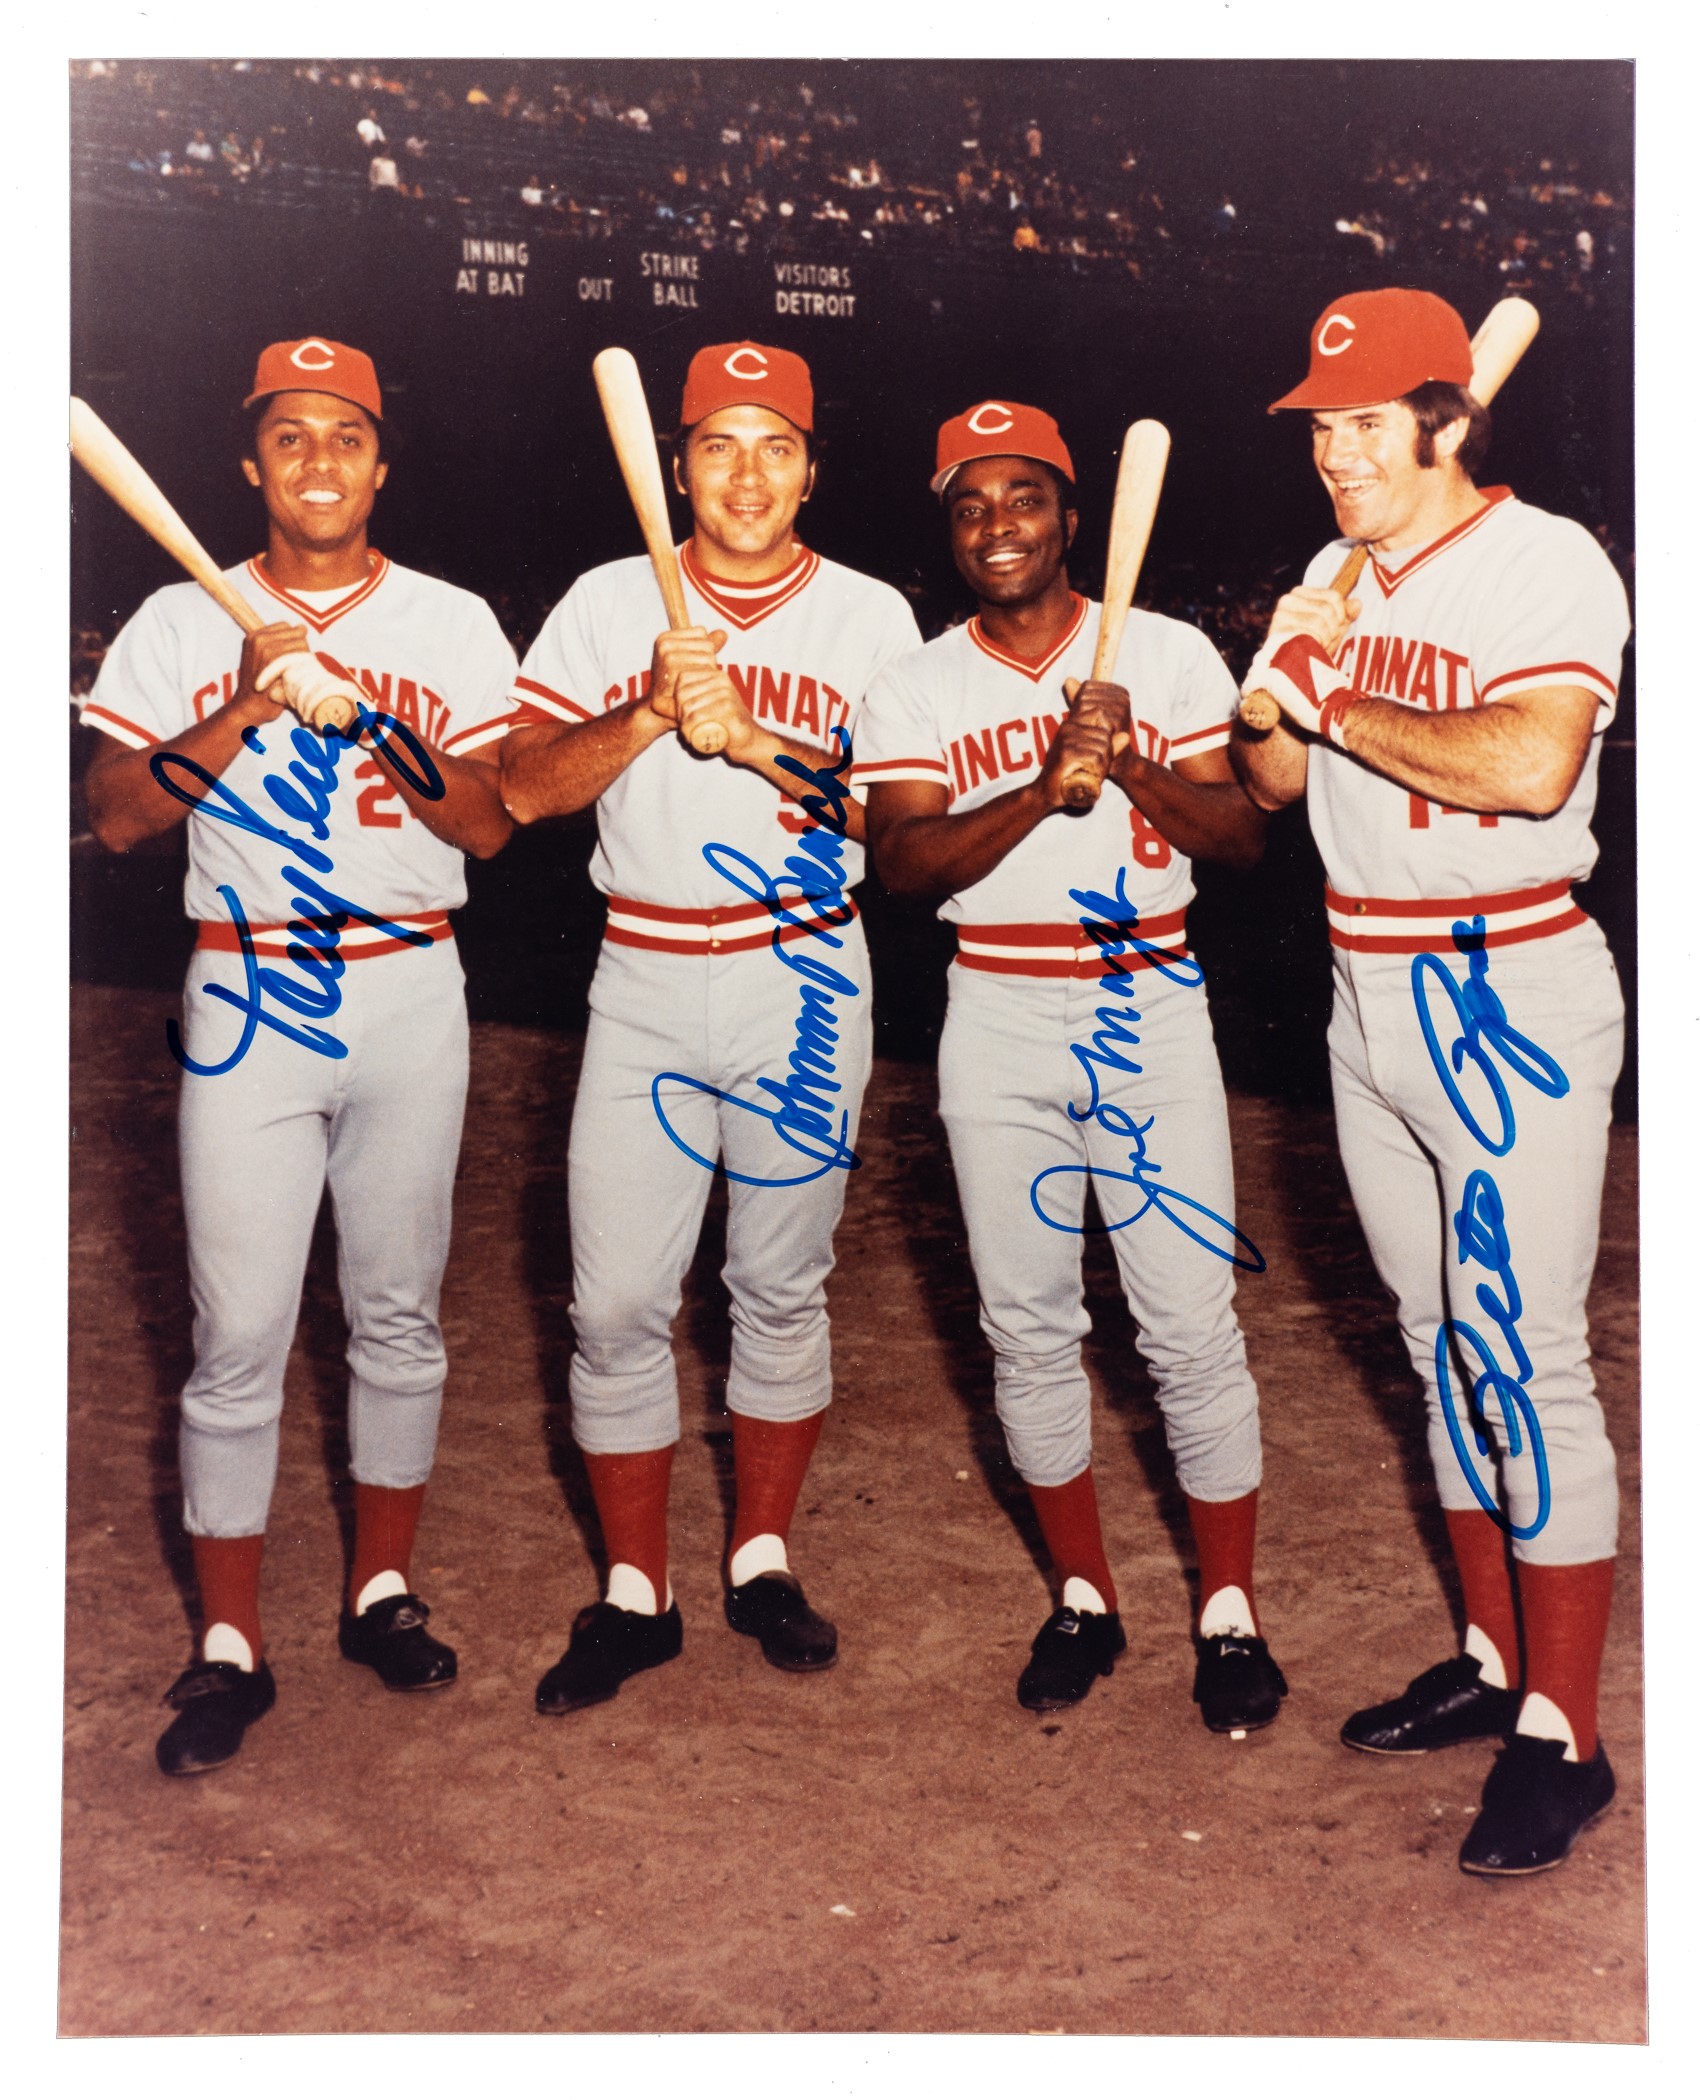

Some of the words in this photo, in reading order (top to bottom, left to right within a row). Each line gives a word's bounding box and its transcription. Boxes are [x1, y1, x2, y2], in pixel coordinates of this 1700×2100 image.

[462, 238, 529, 267] INNING
[640, 252, 699, 280] STRIKE
[456, 269, 478, 294] AT
[487, 271, 525, 297] BAT
[578, 277, 614, 301] OUT
[774, 263, 851, 289] VISITORS
[653, 282, 699, 308] BALL
[775, 291, 856, 317] DETROIT
[1317, 313, 1356, 356] C
[289, 340, 335, 371] C
[723, 347, 769, 380] C
[967, 403, 1013, 435] C
[603, 663, 851, 757] CINNATI
[354, 758, 416, 829] 2
[702, 725, 854, 949] Bench
[1129, 806, 1172, 869] 8
[1411, 913, 1570, 1157] Rose
[652, 925, 862, 1188] Johnny
[1030, 1102, 1267, 1274] Joe
[1435, 1169, 1550, 1540] Pete
